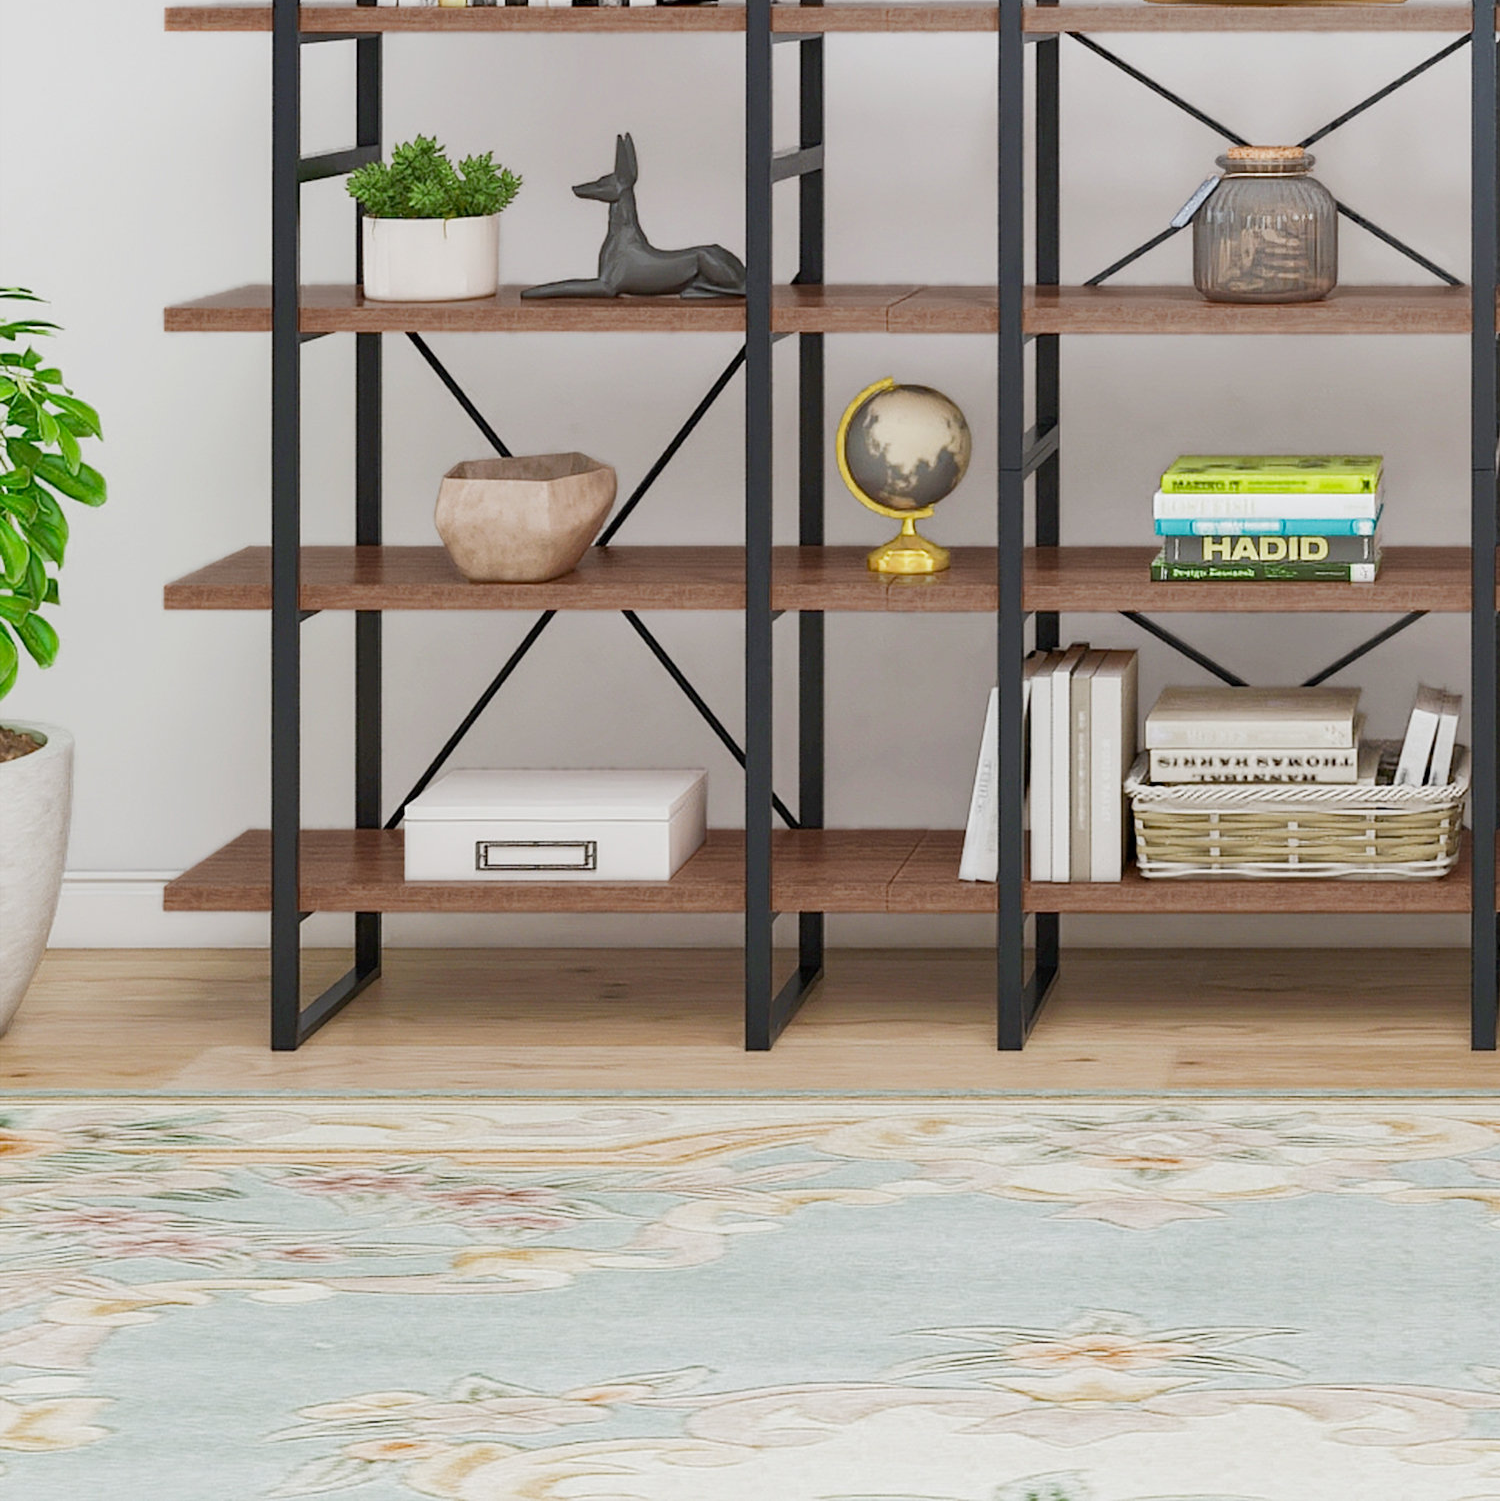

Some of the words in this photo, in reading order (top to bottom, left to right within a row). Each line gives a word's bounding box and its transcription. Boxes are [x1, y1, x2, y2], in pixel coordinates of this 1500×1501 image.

[1202, 535, 1330, 561] HADID
[1156, 756, 1249, 768] HARRIS
[1256, 756, 1354, 768] THOMAS
